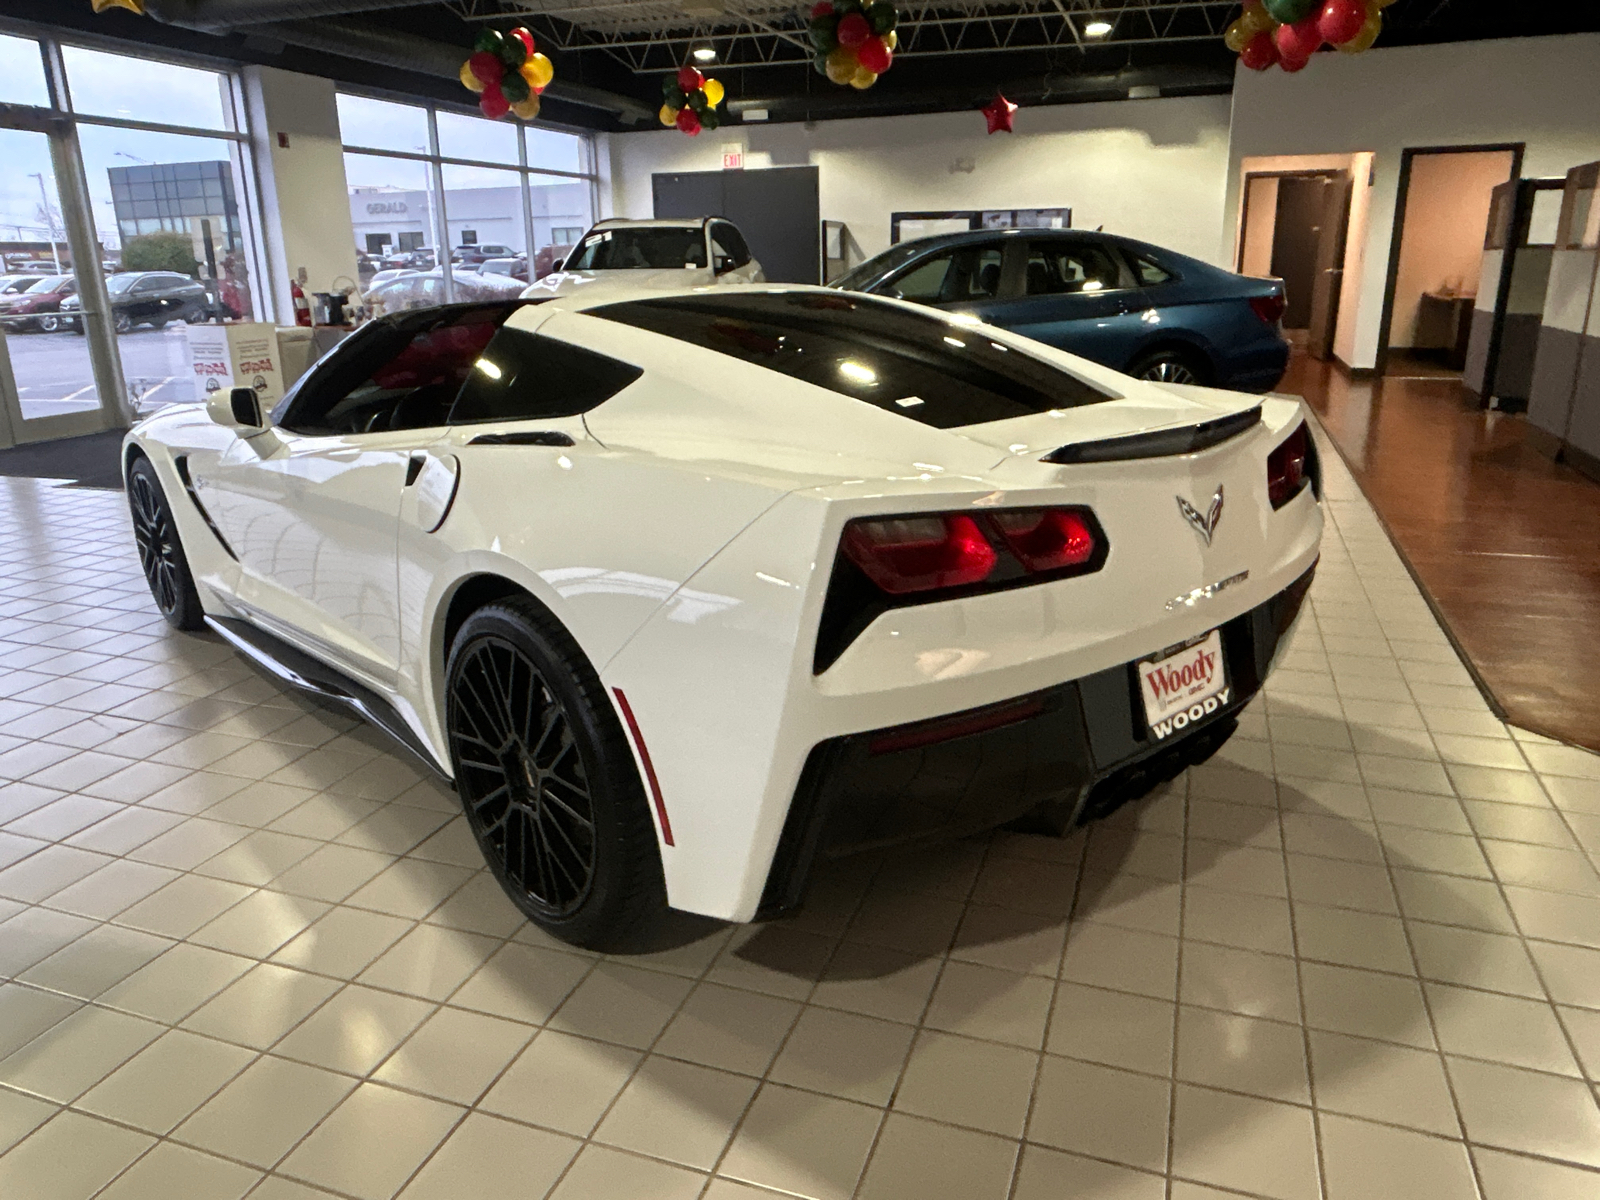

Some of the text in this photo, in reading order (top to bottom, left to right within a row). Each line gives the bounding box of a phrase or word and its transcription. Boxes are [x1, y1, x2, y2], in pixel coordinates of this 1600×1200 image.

[723, 153, 742, 167] EXIT
[366, 201, 408, 215] GERALD
[1146, 649, 1216, 700] Woody
[1152, 687, 1230, 740] WOODY
